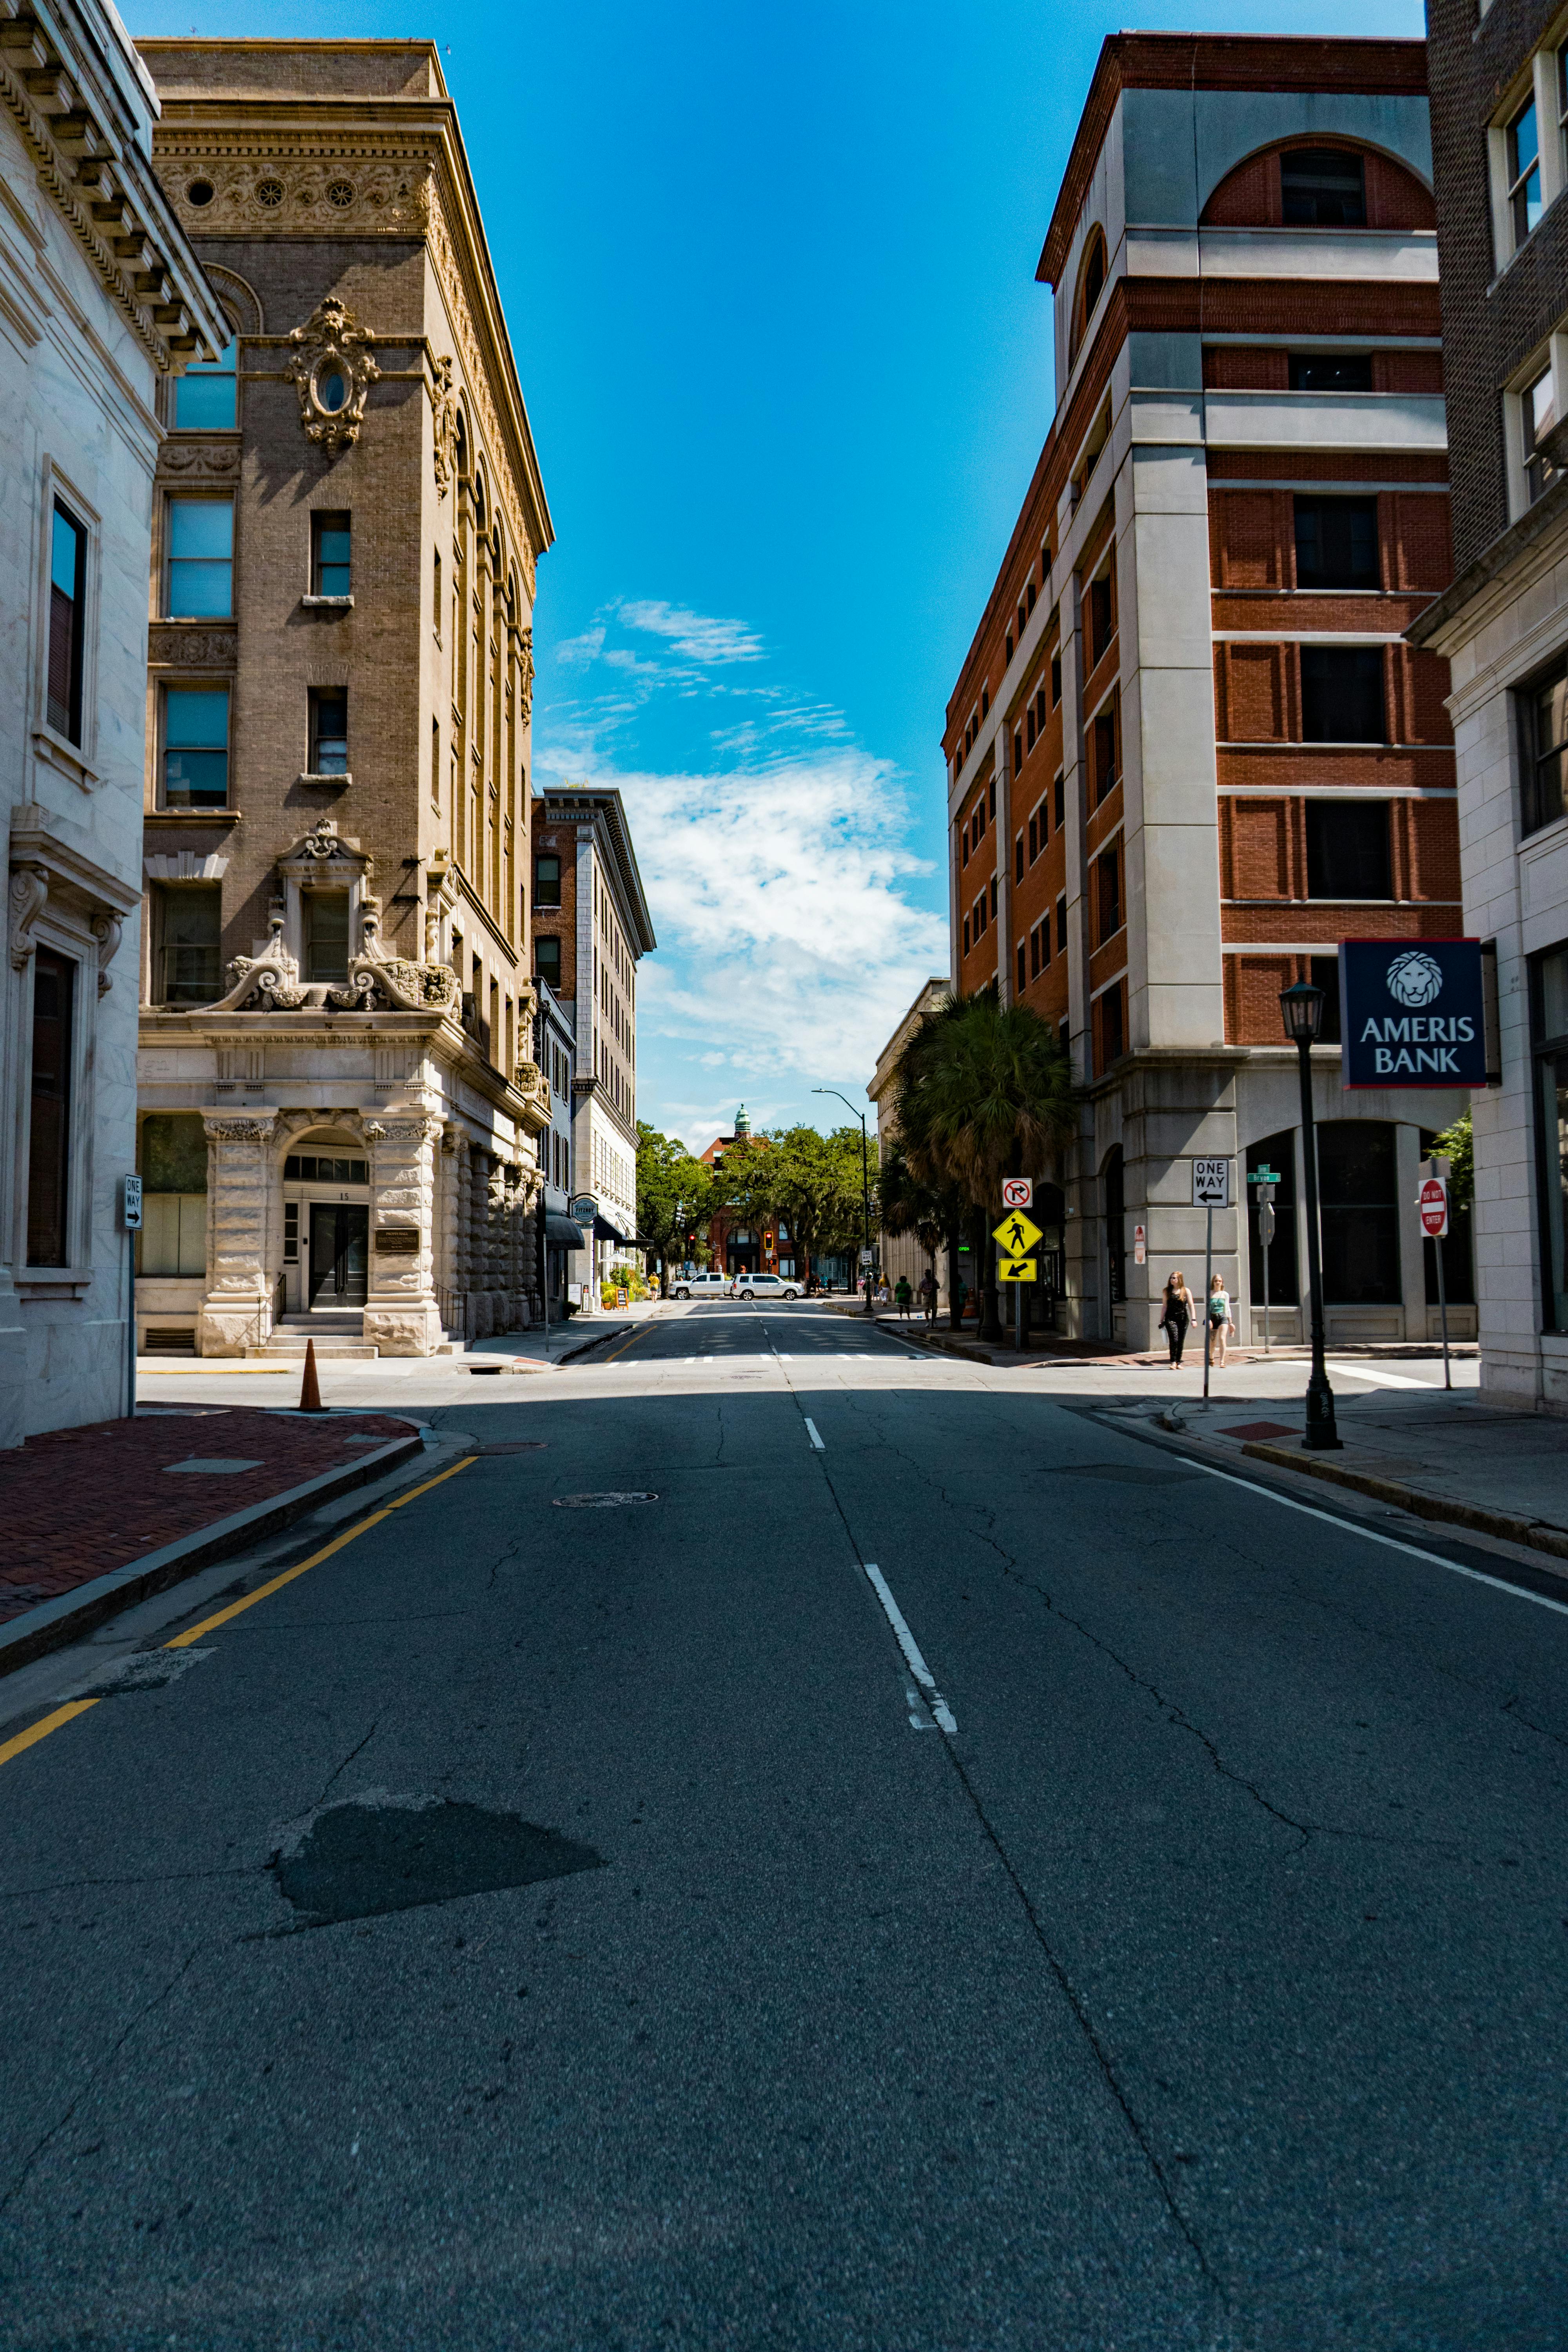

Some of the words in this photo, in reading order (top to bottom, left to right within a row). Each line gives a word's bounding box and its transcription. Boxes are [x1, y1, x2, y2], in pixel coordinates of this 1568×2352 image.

[1360, 1017, 1475, 1042] AMERIS
[1375, 1048, 1461, 1073] BANK
[1197, 1163, 1224, 1174] ONE
[127, 1179, 140, 1193] ONE
[1196, 1176, 1225, 1187] WAY
[127, 1194, 140, 1207] WAY
[341, 1192, 348, 1201] 15
[1423, 1191, 1430, 1200] DO
[1432, 1190, 1442, 1199] NOT
[1425, 1215, 1441, 1225] ENTER
